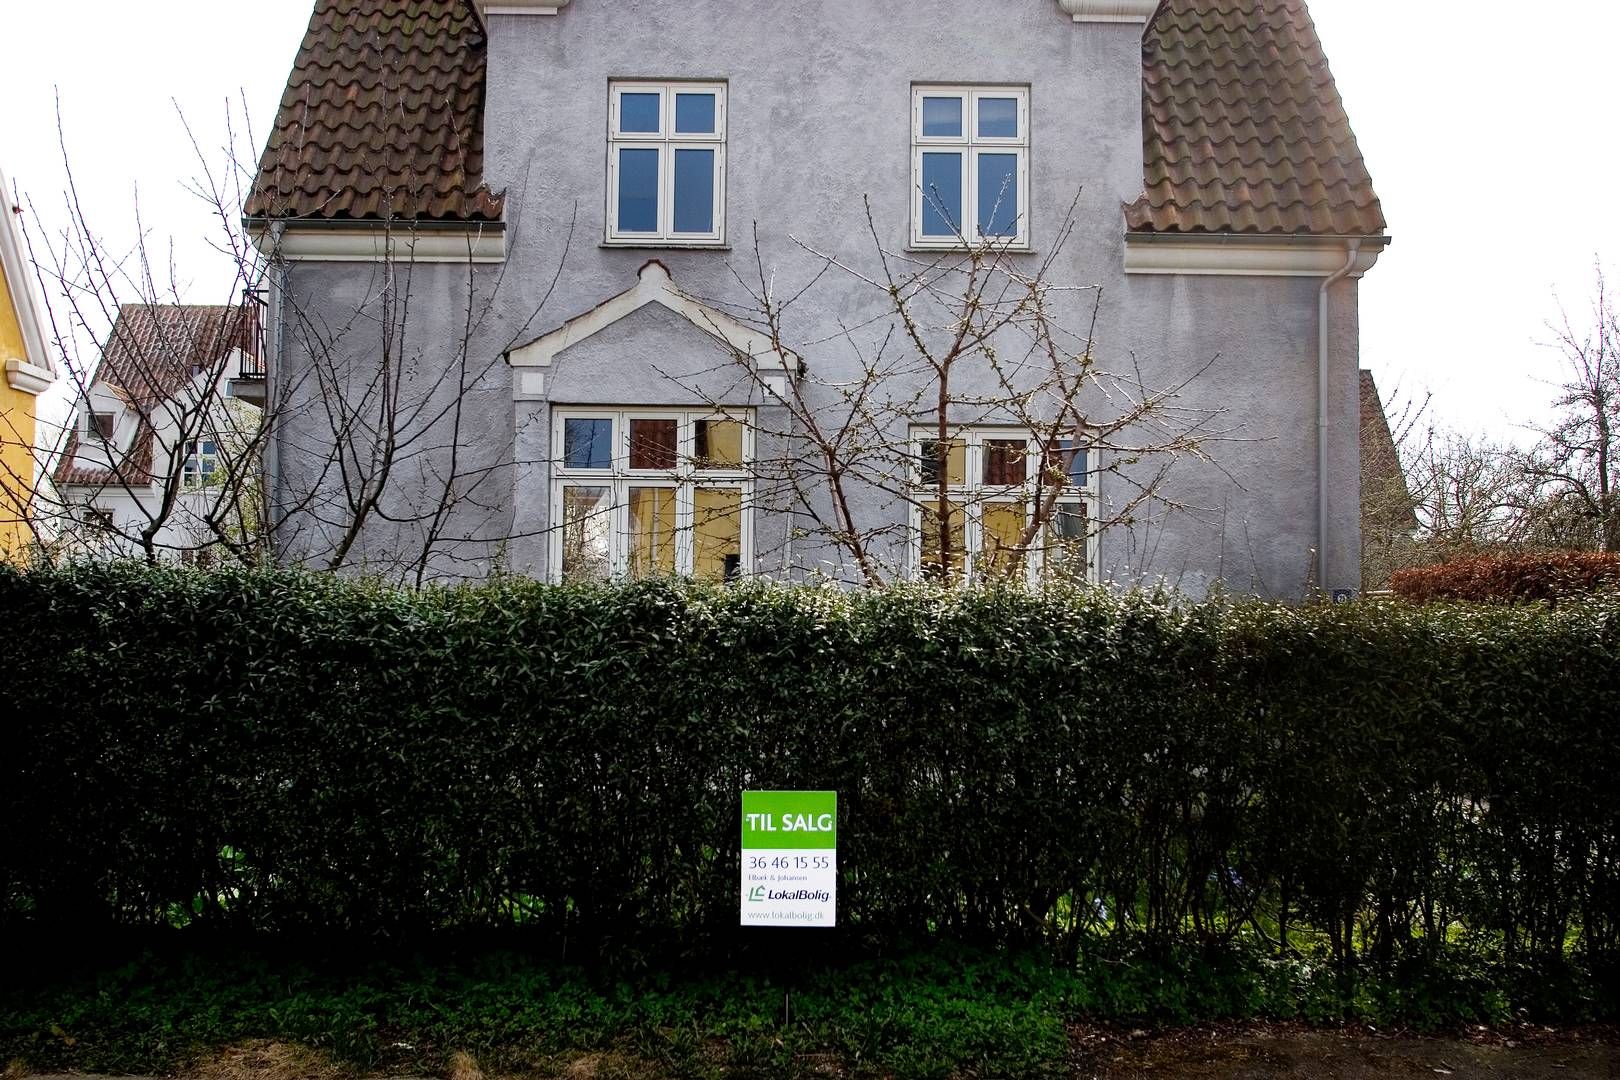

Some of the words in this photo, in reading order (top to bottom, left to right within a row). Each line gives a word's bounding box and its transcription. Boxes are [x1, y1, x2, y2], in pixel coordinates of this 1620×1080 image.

[746, 813, 777, 831] TIL
[782, 813, 832, 831] SALG
[749, 856, 767, 869] 36
[771, 856, 789, 869] 46
[794, 856, 808, 869] 15
[812, 856, 829, 869] 55
[768, 889, 830, 903] LokalBolig
[747, 911, 824, 921] www.lokalbolig.dk
